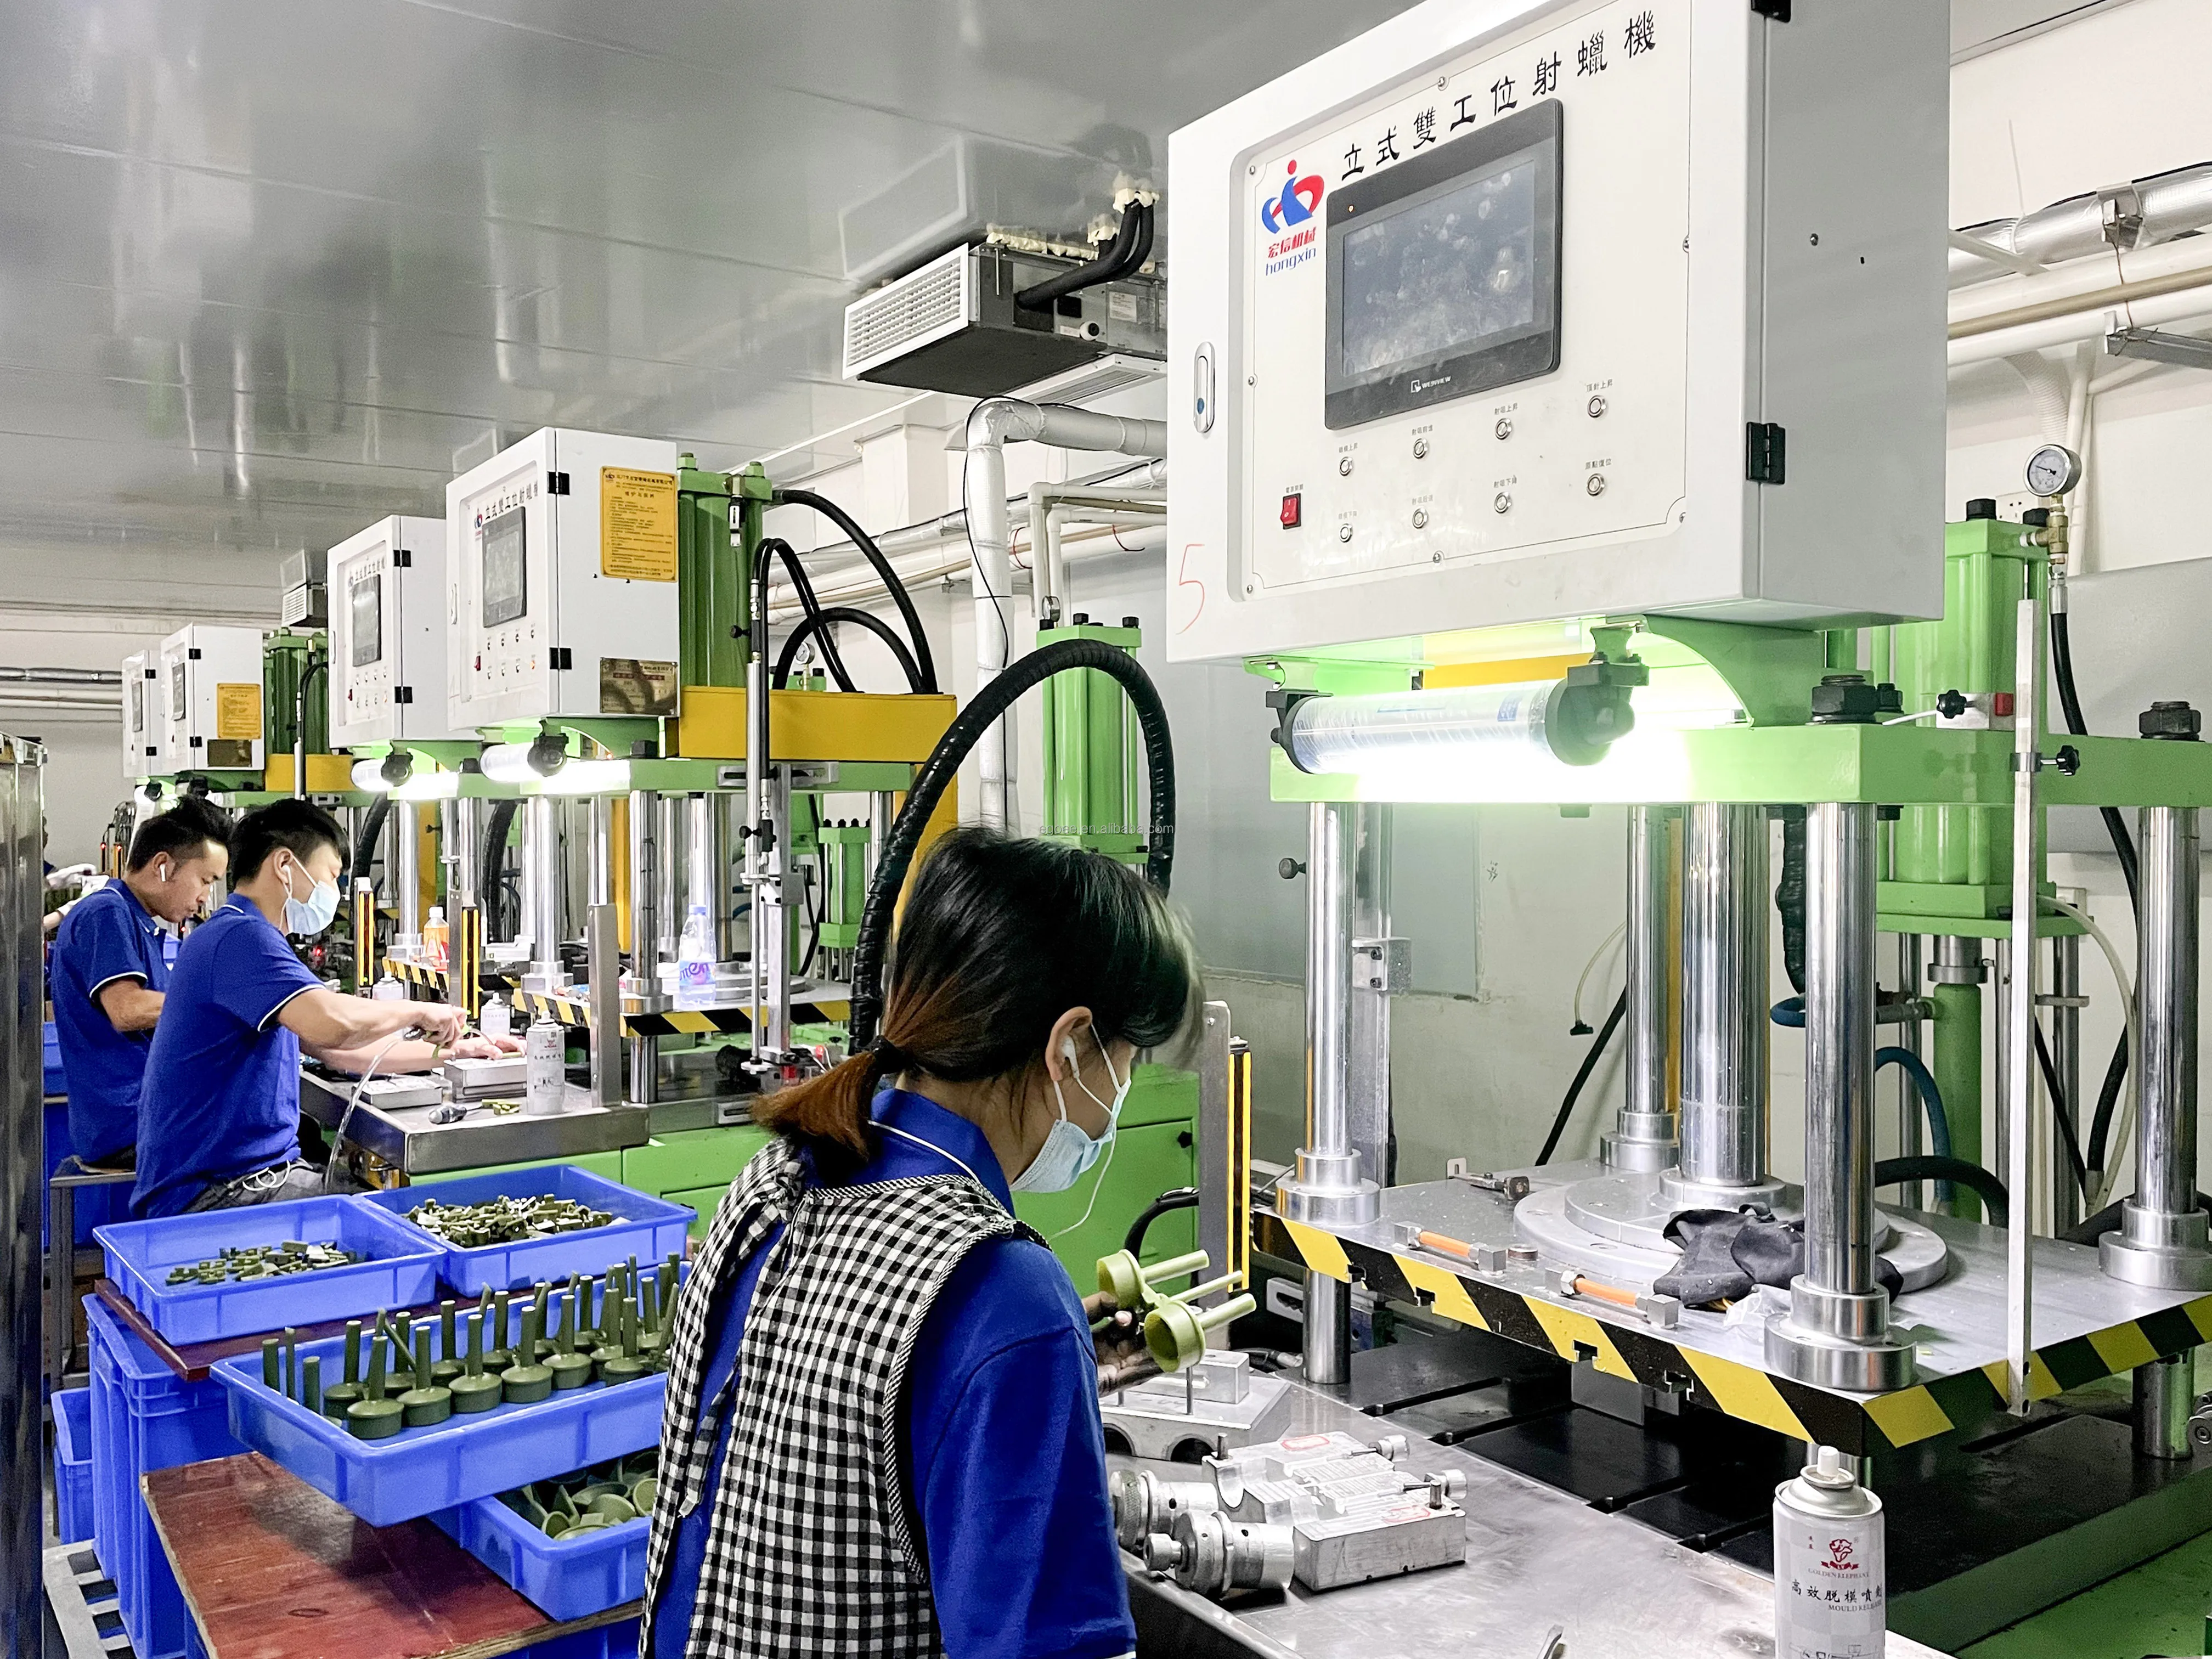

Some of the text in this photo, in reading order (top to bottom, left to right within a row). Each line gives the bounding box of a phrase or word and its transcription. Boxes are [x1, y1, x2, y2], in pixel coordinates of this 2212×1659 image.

[1341, 10, 1656, 181] 立式雙工位射蠟機
[1268, 226, 1317, 258] 宏信机械
[1266, 247, 1316, 276] hongxin
[1176, 544, 1205, 635] 5
[1828, 1604, 1857, 1612] MOULD
